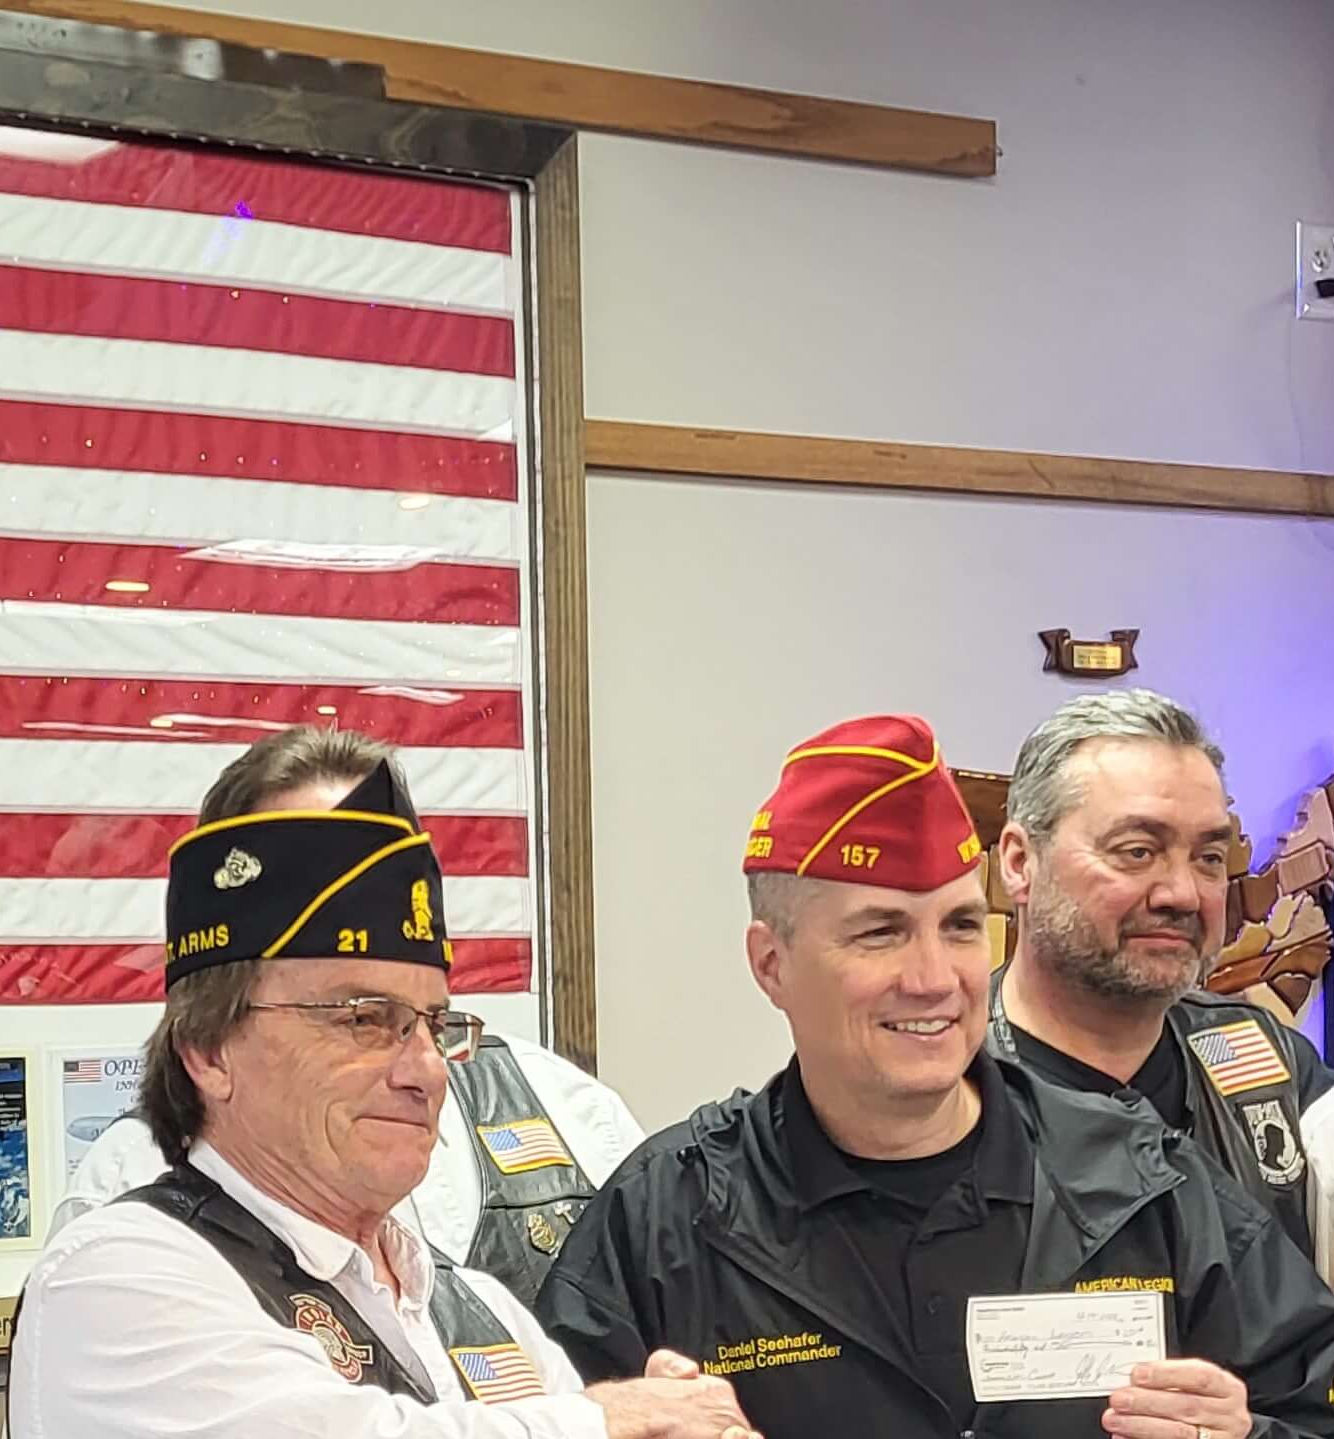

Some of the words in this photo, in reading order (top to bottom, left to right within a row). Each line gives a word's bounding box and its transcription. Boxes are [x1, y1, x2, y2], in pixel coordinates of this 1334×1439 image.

[841, 844, 881, 869] 157
[179, 924, 231, 958] ARMS
[337, 928, 368, 953] 21
[1075, 1276, 1139, 1294] AMERICAN
[718, 1341, 756, 1360] Daniel
[757, 1332, 822, 1352] Seehafer
[703, 1356, 755, 1375] National
[756, 1344, 843, 1368] Commander
